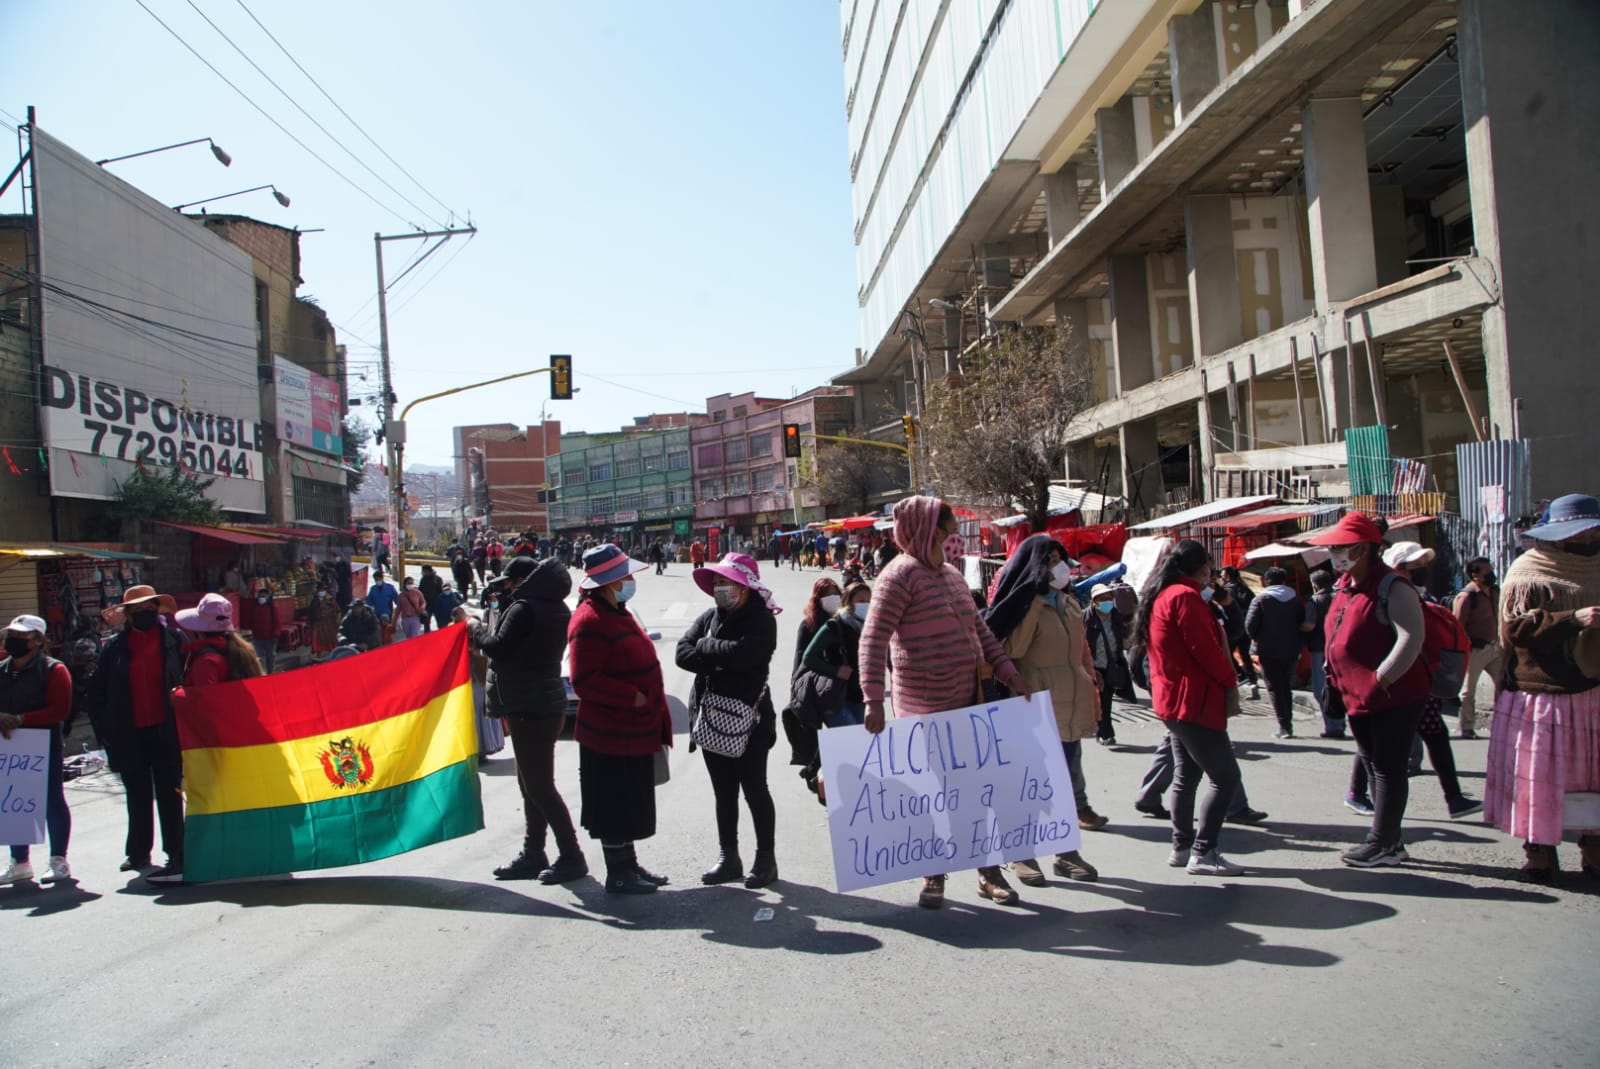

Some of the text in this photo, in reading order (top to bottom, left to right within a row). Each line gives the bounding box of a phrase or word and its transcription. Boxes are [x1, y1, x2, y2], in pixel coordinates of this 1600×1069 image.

[84, 419, 250, 478] 77295044
[1, 784, 36, 814] los
[849, 766, 1054, 827] Atienda a las
[848, 814, 1071, 877] Unidades Educativas
